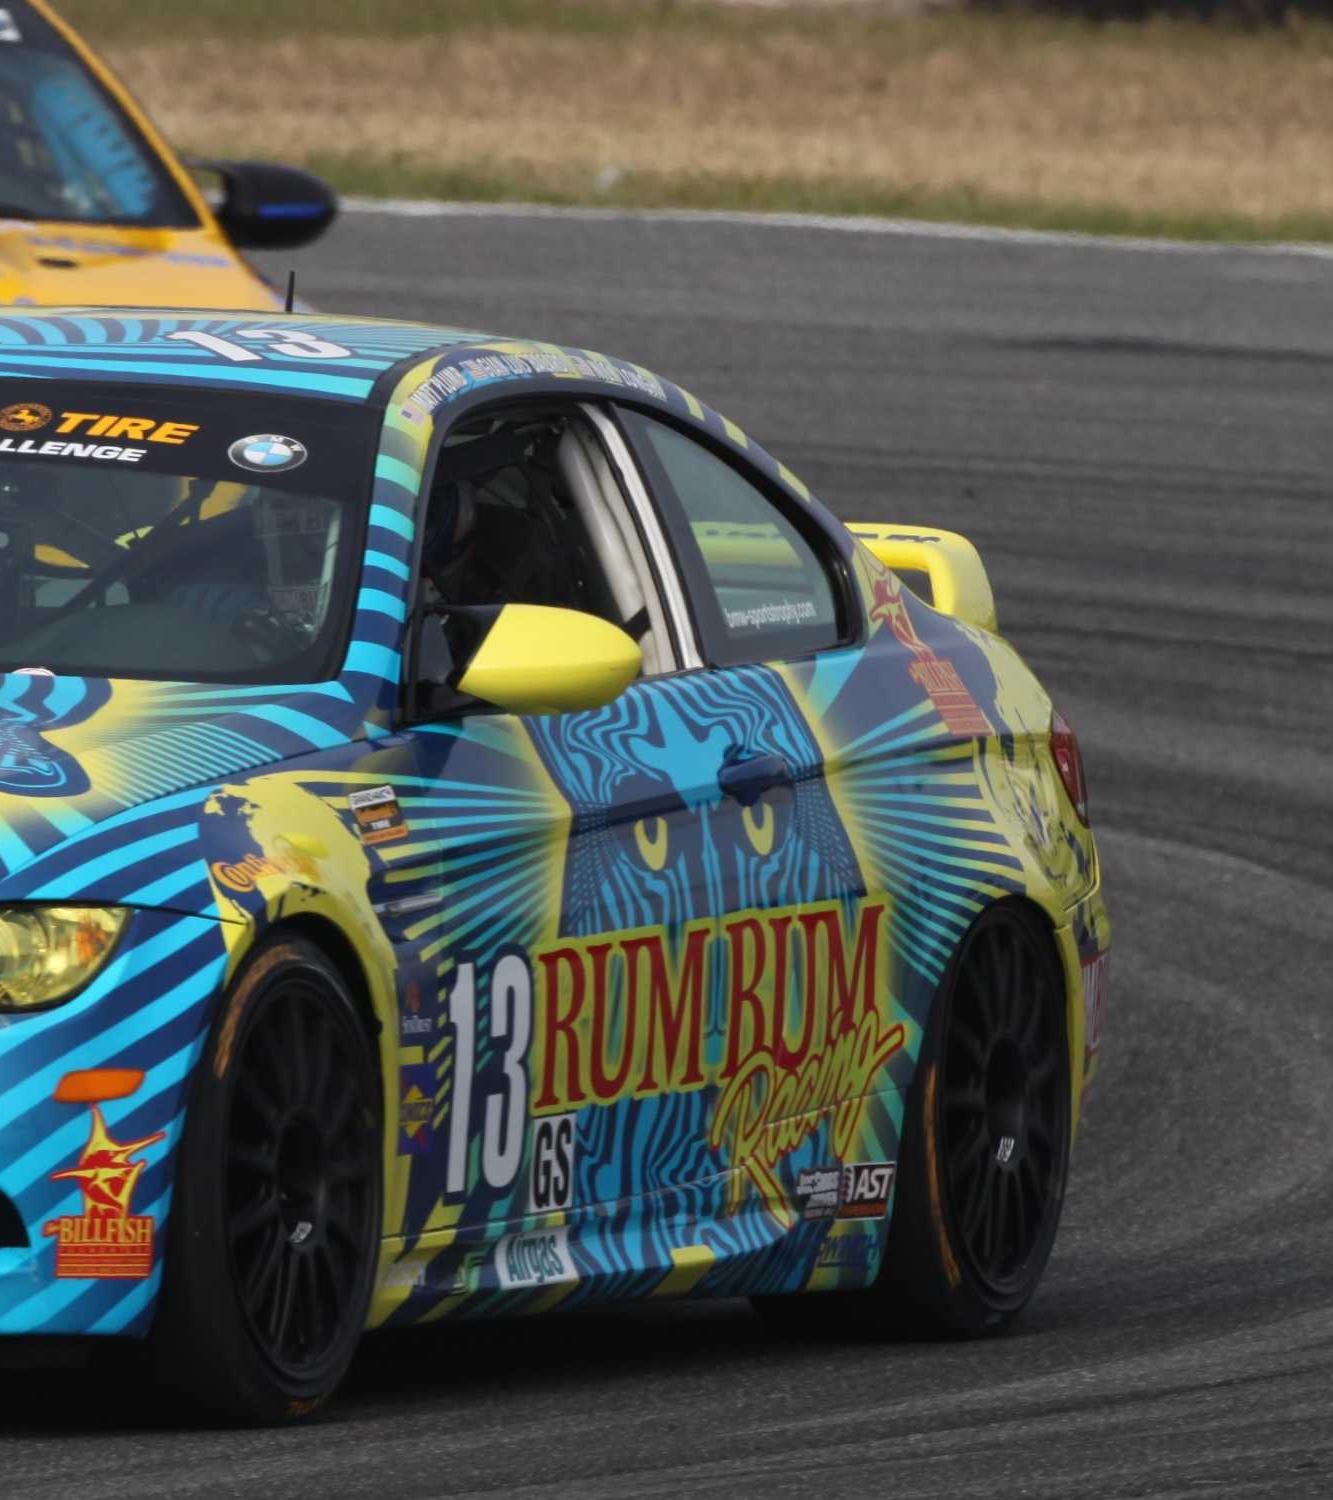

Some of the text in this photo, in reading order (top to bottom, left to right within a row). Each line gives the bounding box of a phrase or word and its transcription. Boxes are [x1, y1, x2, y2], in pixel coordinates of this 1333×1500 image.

[166, 329, 354, 362] 13
[56, 411, 200, 446] TIRE
[532, 903, 886, 1110] RUM BUM
[445, 953, 534, 1194] 13
[710, 1004, 905, 1231] Racing
[533, 1117, 573, 1209] GS
[853, 1166, 894, 1201] AST
[59, 1216, 153, 1244] BILLFISH
[506, 1234, 566, 1284] Airgas
